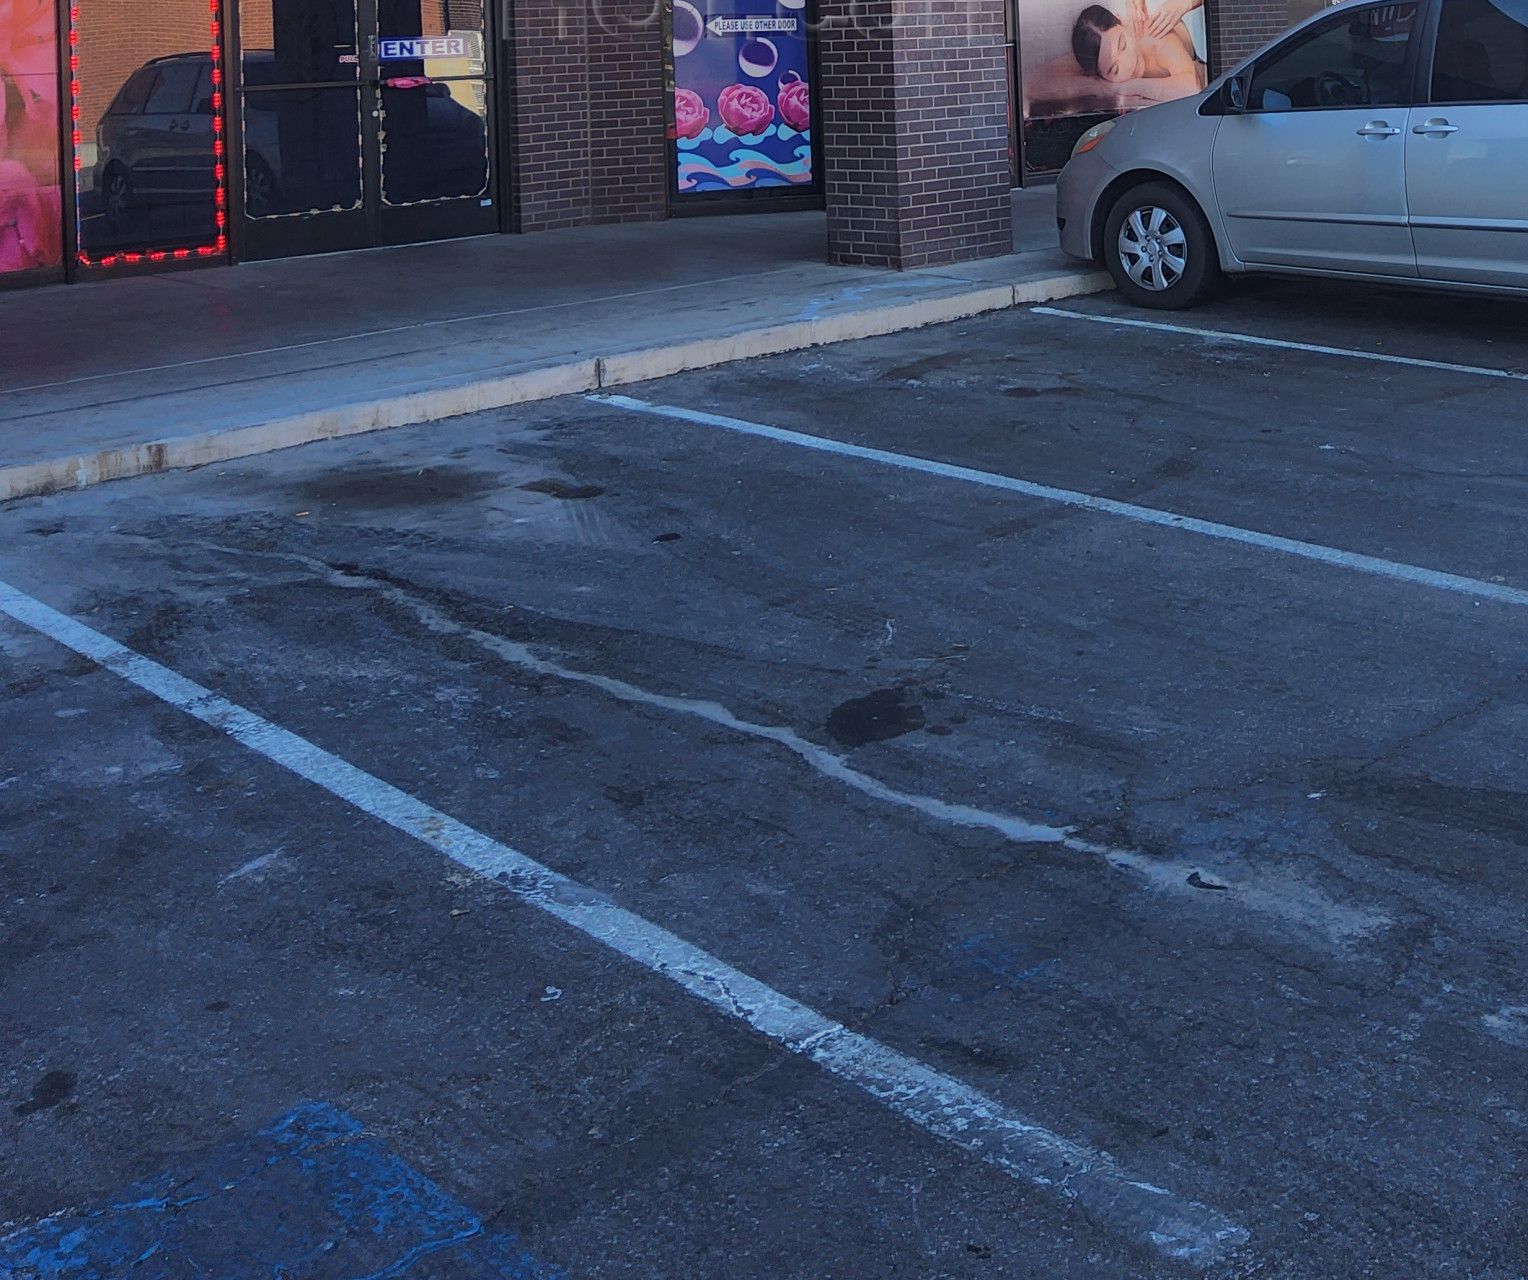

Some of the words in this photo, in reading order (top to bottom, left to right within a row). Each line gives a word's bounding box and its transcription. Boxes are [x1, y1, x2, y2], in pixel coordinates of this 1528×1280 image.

[714, 21, 739, 31] PLEASE
[740, 21, 753, 30] USE
[754, 20, 776, 30] OTHER
[777, 19, 796, 30] DOOR
[383, 40, 460, 56] ENTER
